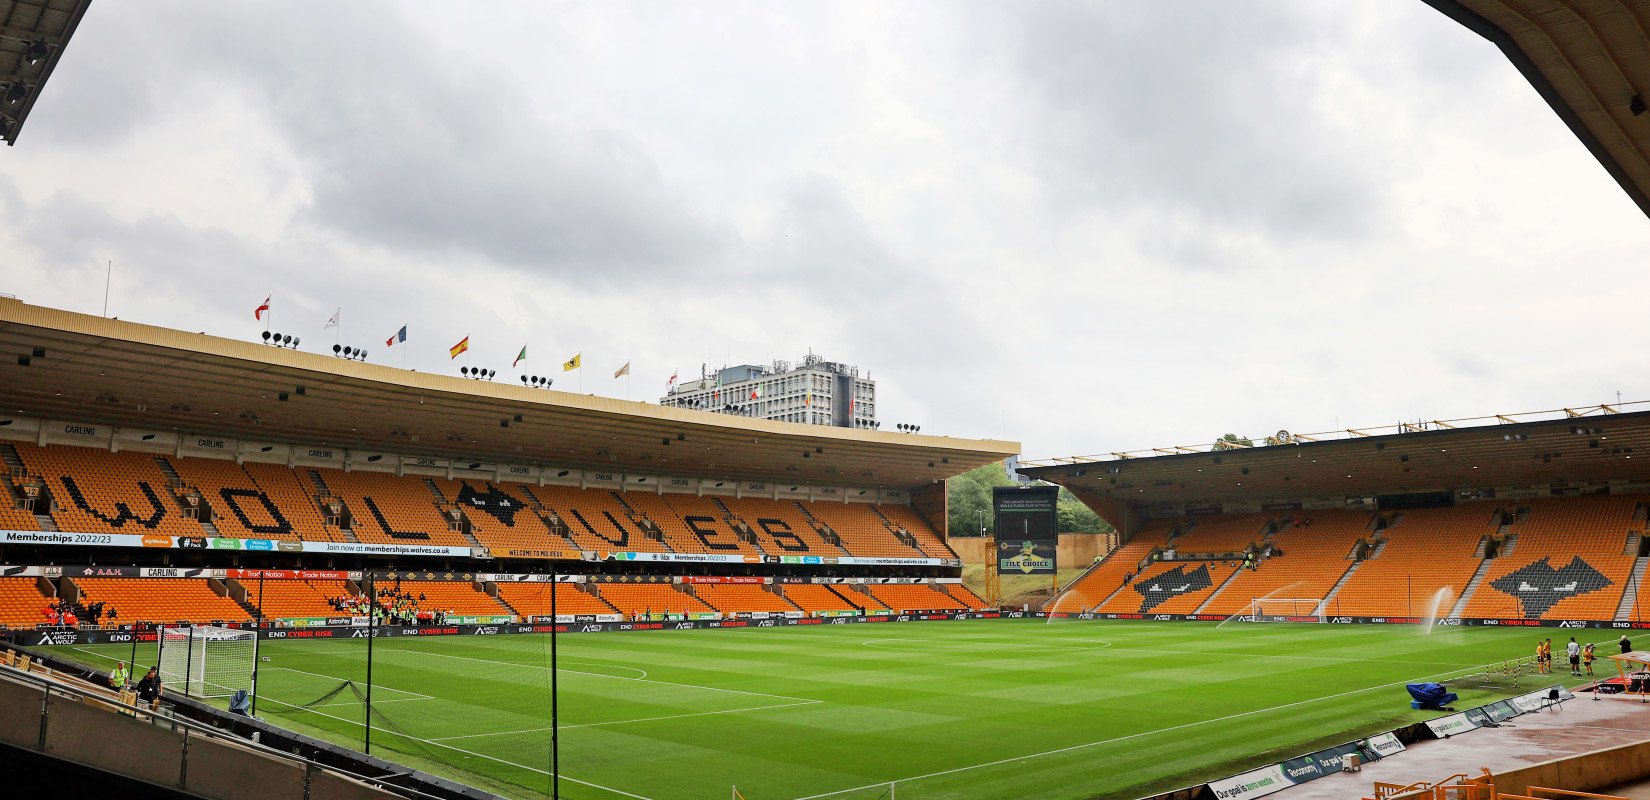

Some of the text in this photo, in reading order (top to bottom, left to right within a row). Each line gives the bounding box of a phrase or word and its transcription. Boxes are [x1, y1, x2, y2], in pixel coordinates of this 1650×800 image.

[65, 424, 95, 437] CARLING
[198, 438, 224, 449] CARLING
[308, 450, 333, 458] CARLING
[417, 458, 436, 466] CARLING
[510, 466, 530, 475] CARLING
[6, 532, 112, 544] Memberships 2022/23
[326, 544, 341, 552] Join
[365, 546, 450, 555] memberships.wolves.co.uk
[148, 568, 177, 576] CARLING
[464, 616, 510, 624] bet365.com
[1328, 755, 1339, 766] goal
[1287, 764, 1318, 778] Reconomy
[1216, 777, 1274, 799] Our goal is zero waste
